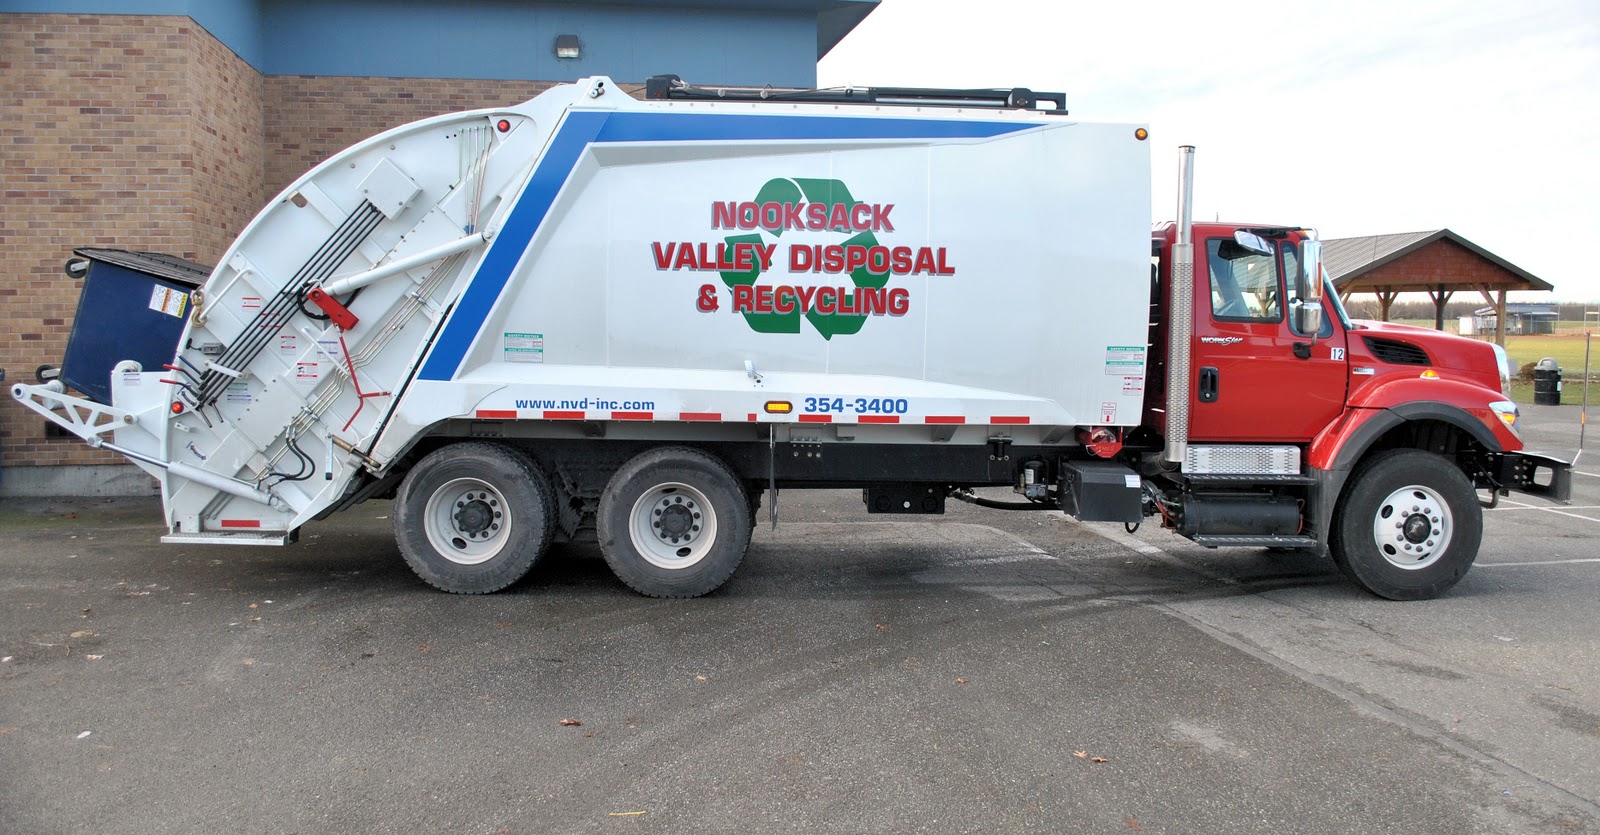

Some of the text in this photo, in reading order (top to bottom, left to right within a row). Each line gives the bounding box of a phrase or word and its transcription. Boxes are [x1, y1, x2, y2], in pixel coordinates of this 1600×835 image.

[711, 201, 896, 232] NOOKSACK
[651, 241, 956, 276] VALLEY DISPOSAL
[696, 283, 910, 316] & RECYCLING
[1333, 348, 1344, 360] 12
[515, 397, 656, 411] www.nvd-inc.com
[804, 397, 908, 414] 354-3400
